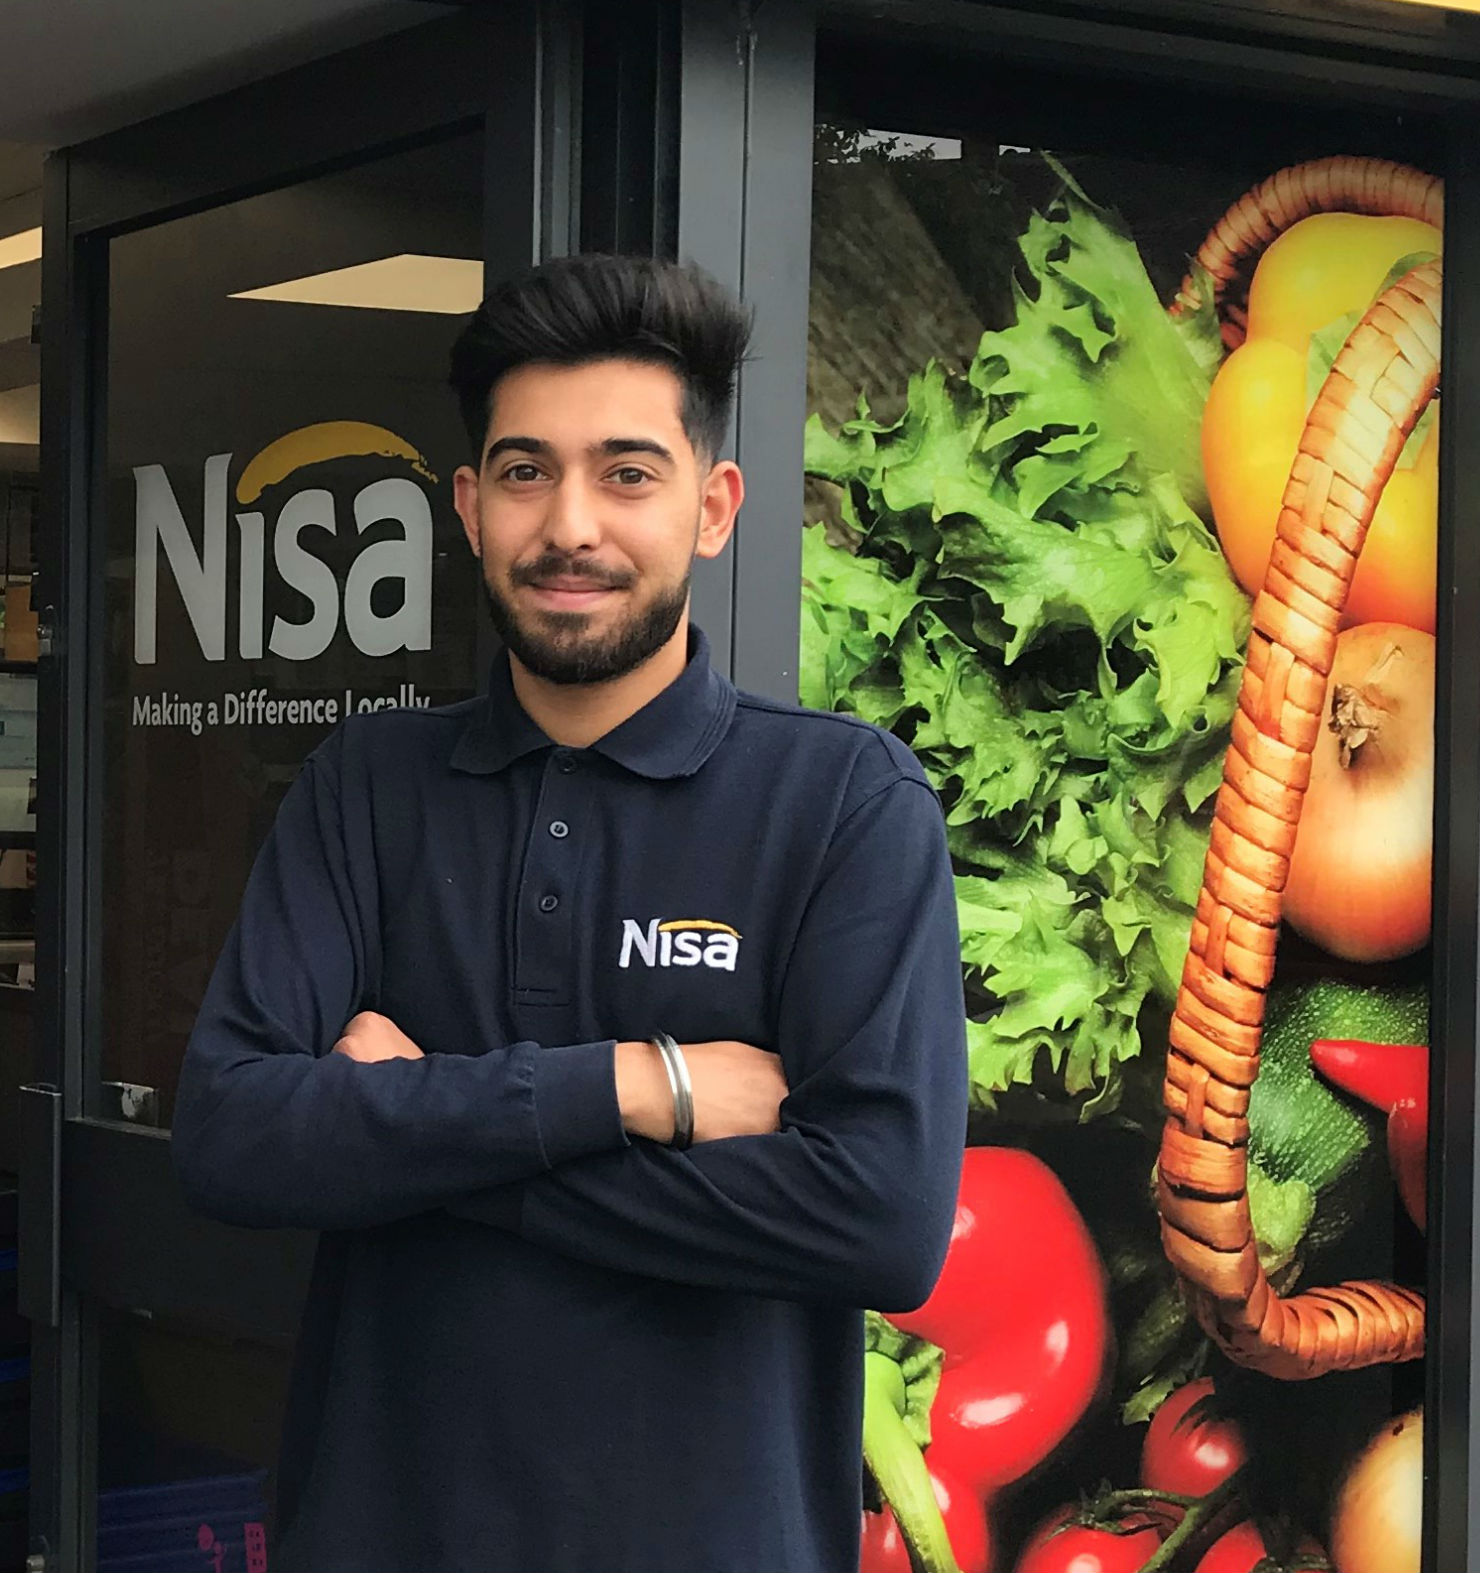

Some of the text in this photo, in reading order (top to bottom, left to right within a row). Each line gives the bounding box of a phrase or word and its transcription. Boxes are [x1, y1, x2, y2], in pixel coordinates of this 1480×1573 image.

[132, 453, 434, 665] Nisa
[132, 691, 204, 736] Making
[207, 704, 219, 725] a
[224, 688, 338, 725] Difference
[618, 918, 739, 972] Nisa
